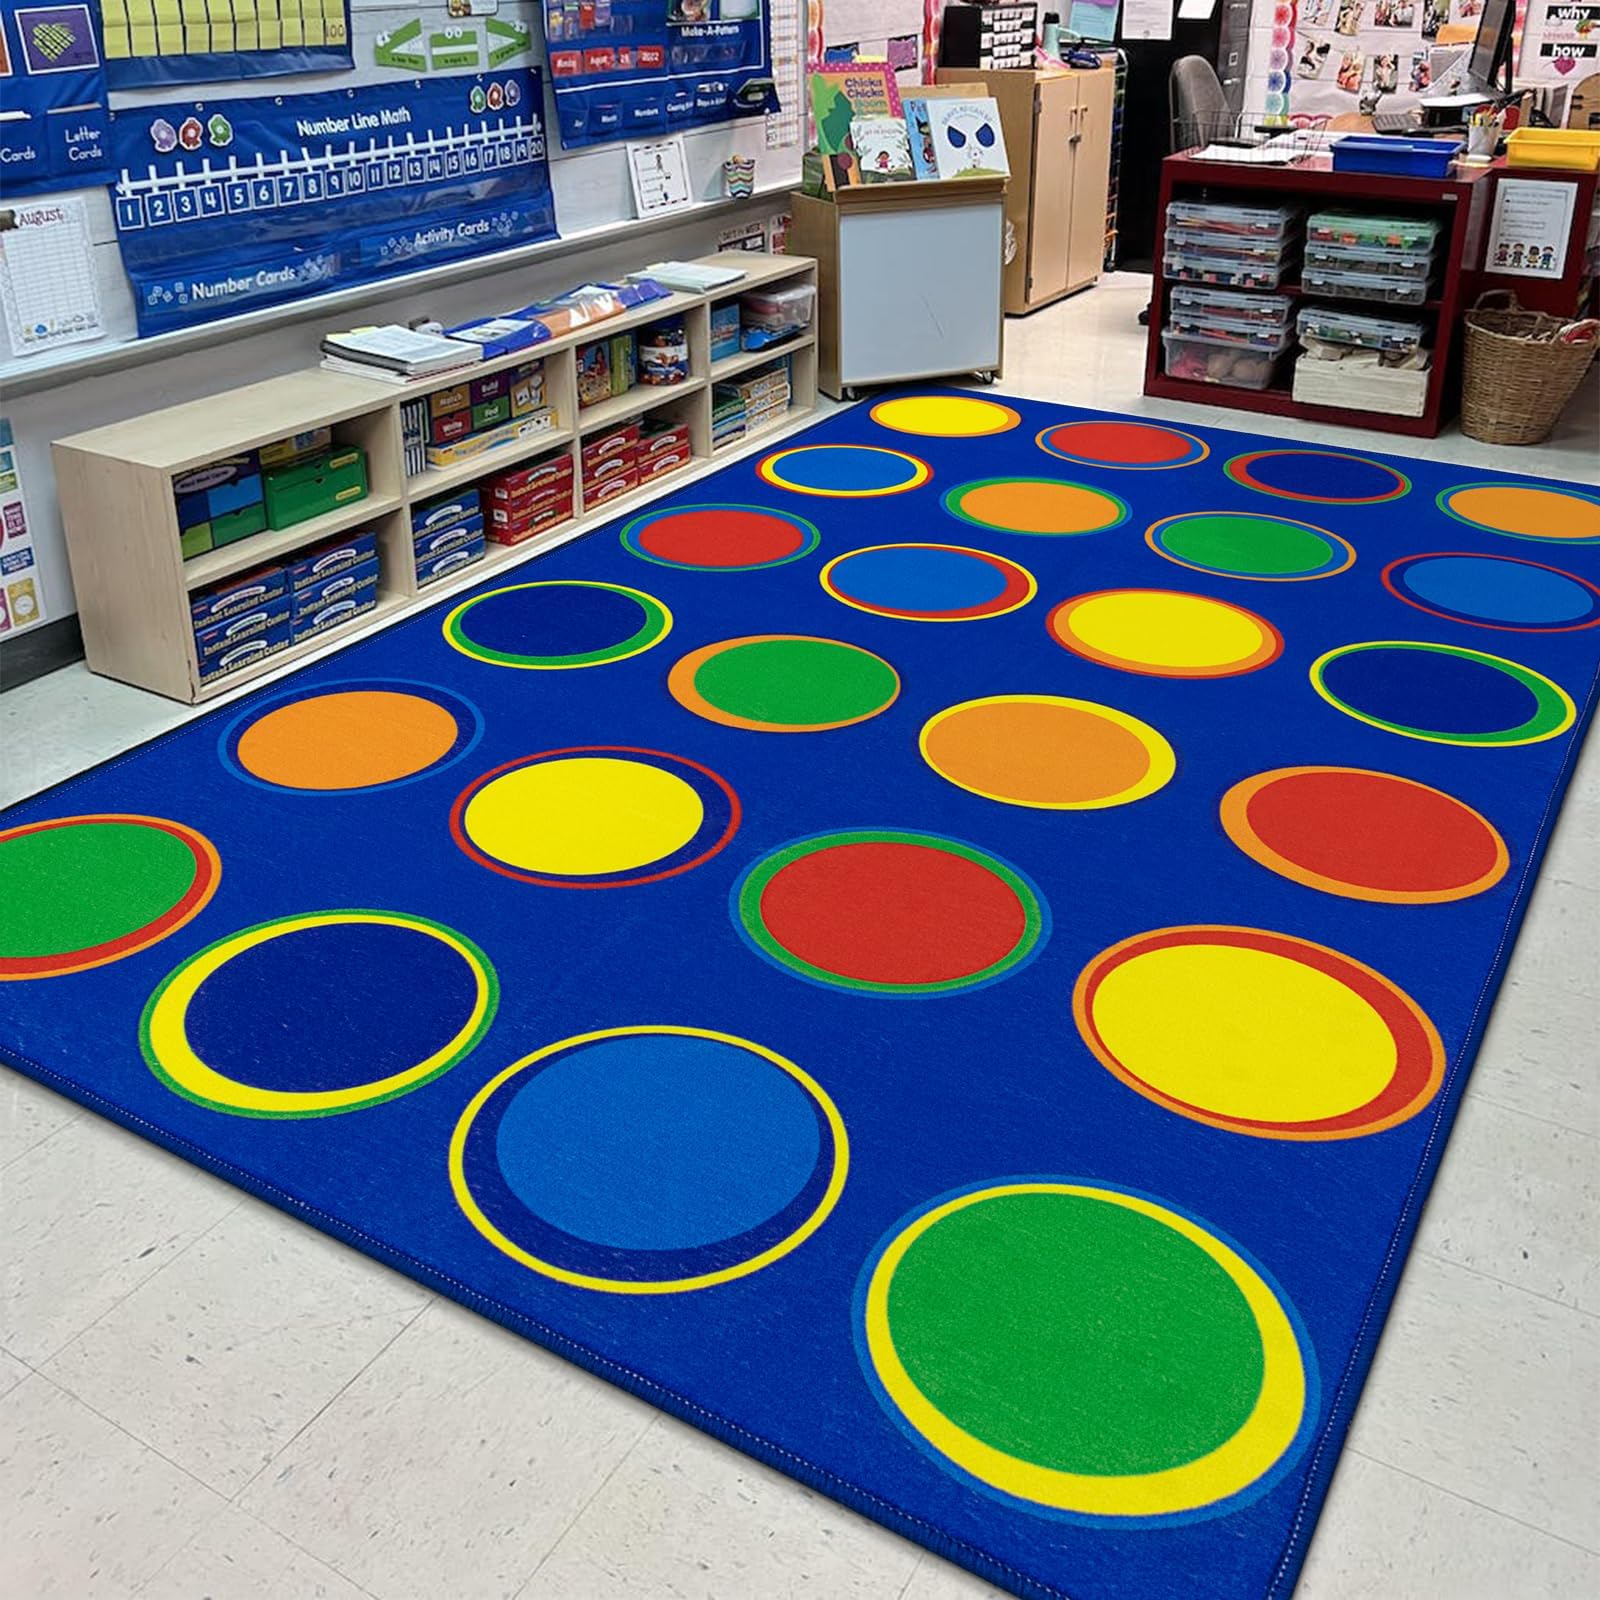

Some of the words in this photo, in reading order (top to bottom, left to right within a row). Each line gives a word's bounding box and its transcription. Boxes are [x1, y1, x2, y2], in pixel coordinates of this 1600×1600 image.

[1558, 6, 1590, 20] why
[1552, 43, 1586, 57] how
[844, 77, 882, 89] Chicka
[846, 88, 884, 99] Chicka
[297, 117, 350, 137] Number
[351, 113, 380, 130] Line
[381, 106, 412, 126] Math
[65, 126, 101, 144] Letter
[1, 148, 36, 163] Cards
[69, 143, 102, 162] Cards
[127, 210, 134, 221] 1
[154, 202, 166, 217] 2
[180, 198, 192, 212] 3
[205, 192, 217, 208] 4
[234, 188, 244, 205] 5
[259, 186, 270, 200] 6
[284, 182, 294, 198] 7
[308, 178, 318, 194] 8
[330, 175, 340, 190] 9
[350, 171, 362, 186] 10
[370, 168, 380, 182] 11
[389, 164, 401, 180] 12
[409, 161, 422, 176] 13
[429, 158, 441, 174] 14
[448, 154, 459, 170] 15
[466, 152, 478, 168] 16
[484, 148, 494, 164] 17
[500, 146, 511, 161] 18
[516, 142, 527, 158] 19
[532, 140, 544, 156] 20
[413, 226, 456, 248] Activity
[456, 219, 490, 238] Cards
[192, 275, 253, 300] Number
[255, 266, 296, 286] Cards
